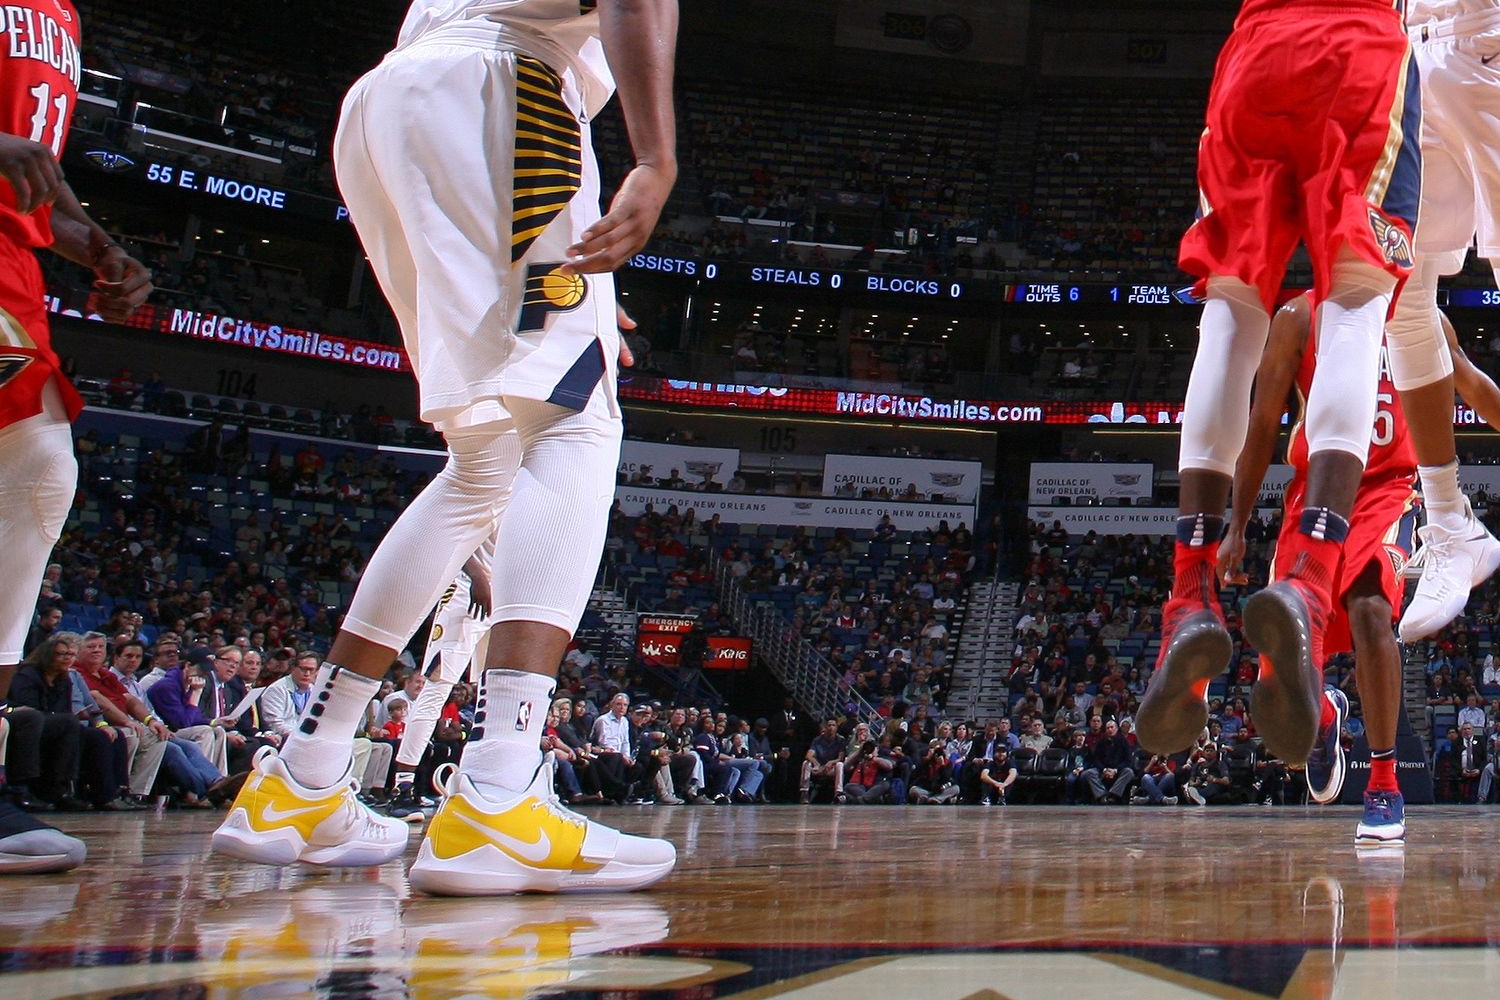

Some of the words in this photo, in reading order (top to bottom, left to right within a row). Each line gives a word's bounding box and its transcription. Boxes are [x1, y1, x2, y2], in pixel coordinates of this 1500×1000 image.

[30, 83, 67, 157] 11
[147, 163, 172, 183] 55
[178, 170, 198, 189] E.
[205, 176, 286, 209] MOORE
[706, 264, 717, 279] 0
[751, 267, 820, 287] STEALS
[830, 274, 842, 289] 0
[867, 276, 939, 296] BLOCKS
[950, 283, 961, 299] 0
[1029, 284, 1059, 294] TIME
[1069, 288, 1079, 301] 6
[1110, 287, 1118, 301] 1
[1131, 286, 1168, 295] TEAM
[1026, 293, 1061, 303] OUTS
[1128, 295, 1170, 304] FOULS
[170, 308, 401, 370] MidCitySmiles.com
[216, 369, 257, 399] 104
[836, 391, 1043, 422] MidCitySmiles.com
[1371, 393, 1395, 446] 5
[760, 426, 797, 452] 105
[834, 474, 885, 485] CADILLAC
[889, 476, 902, 485] OF
[1036, 478, 1078, 486] CADILLAC
[1080, 478, 1091, 486] OF
[1036, 487, 1056, 495] NEW
[1058, 487, 1097, 495] ORLEANS
[625, 494, 674, 506] CADILLAC
[678, 498, 690, 507] OF
[693, 500, 716, 509] NEW
[720, 502, 767, 511] ORLEANS
[824, 506, 873, 516] CADILLAC
[876, 508, 889, 516] OF
[893, 509, 914, 517] NEW
[918, 510, 962, 519] ORLEANS
[1065, 514, 1110, 523] CADILLAC
[1113, 514, 1124, 522] OF
[1129, 514, 1148, 522] NEW
[1152, 514, 1176, 523] ORLE
[643, 618, 694, 627] EMERGENCY
